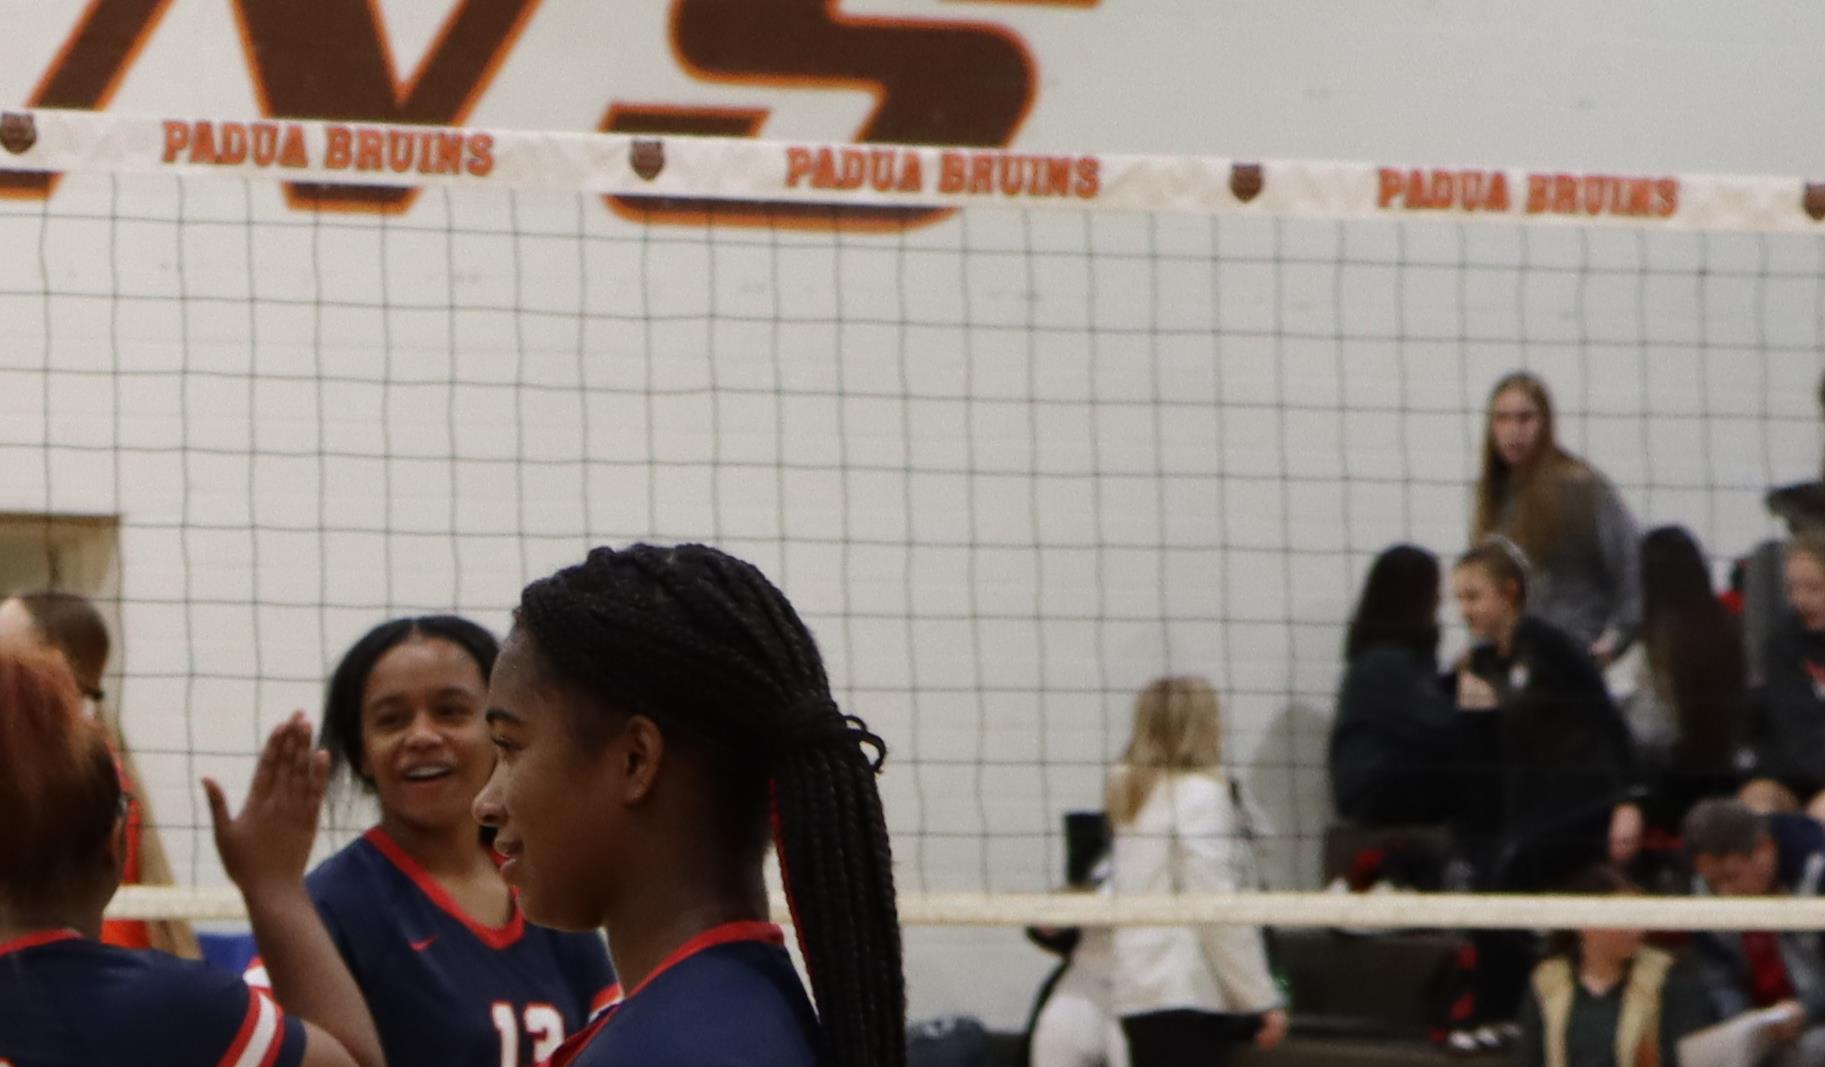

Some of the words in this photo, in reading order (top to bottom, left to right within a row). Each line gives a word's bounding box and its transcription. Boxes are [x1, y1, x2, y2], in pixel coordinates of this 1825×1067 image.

[161, 119, 309, 169] PADUA
[323, 124, 495, 177] BRUINS
[784, 146, 922, 193] PADUA
[937, 152, 1101, 199] BRUINS
[1377, 166, 1511, 212] PADUA
[1526, 171, 1680, 218] BRUINS
